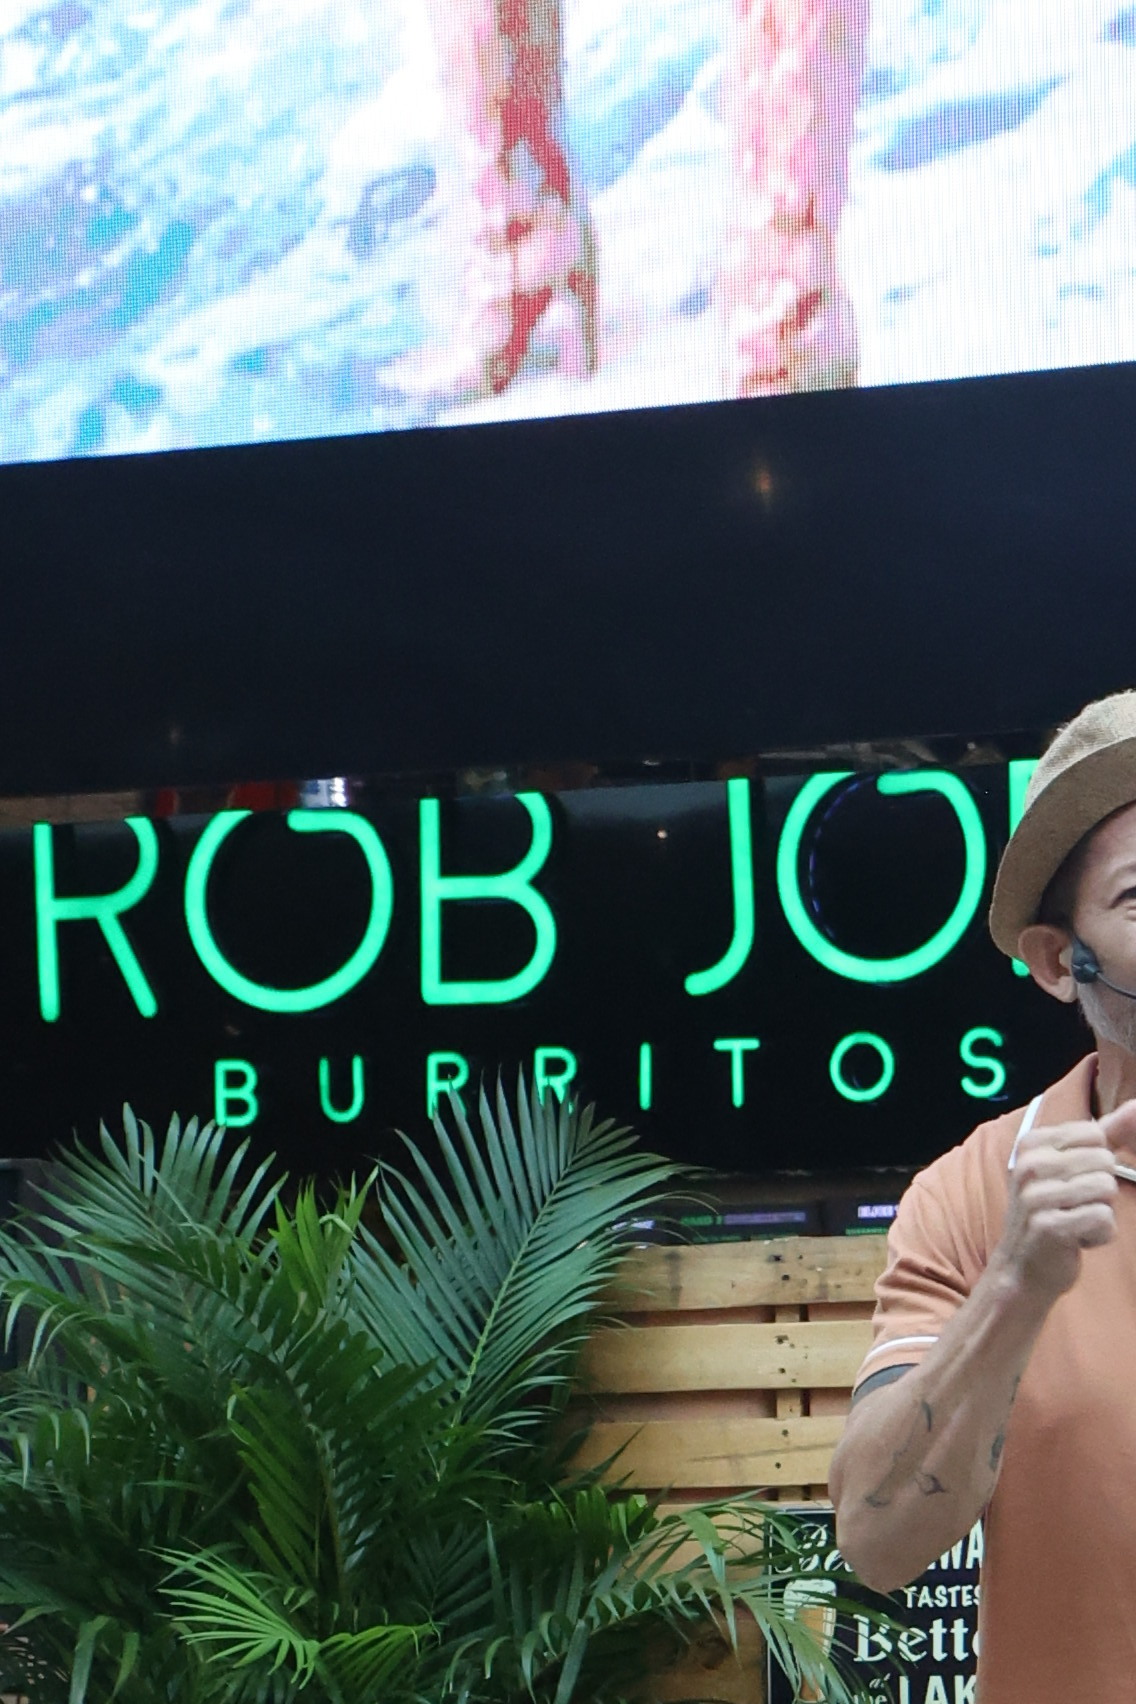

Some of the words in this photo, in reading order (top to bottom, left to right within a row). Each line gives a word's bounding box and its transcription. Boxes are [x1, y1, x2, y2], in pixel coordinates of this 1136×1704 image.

[34, 791, 558, 1022] ROB
[684, 759, 1040, 996] JO
[213, 1026, 1006, 1128] BURRITOS
[853, 1613, 980, 1662] Bett
